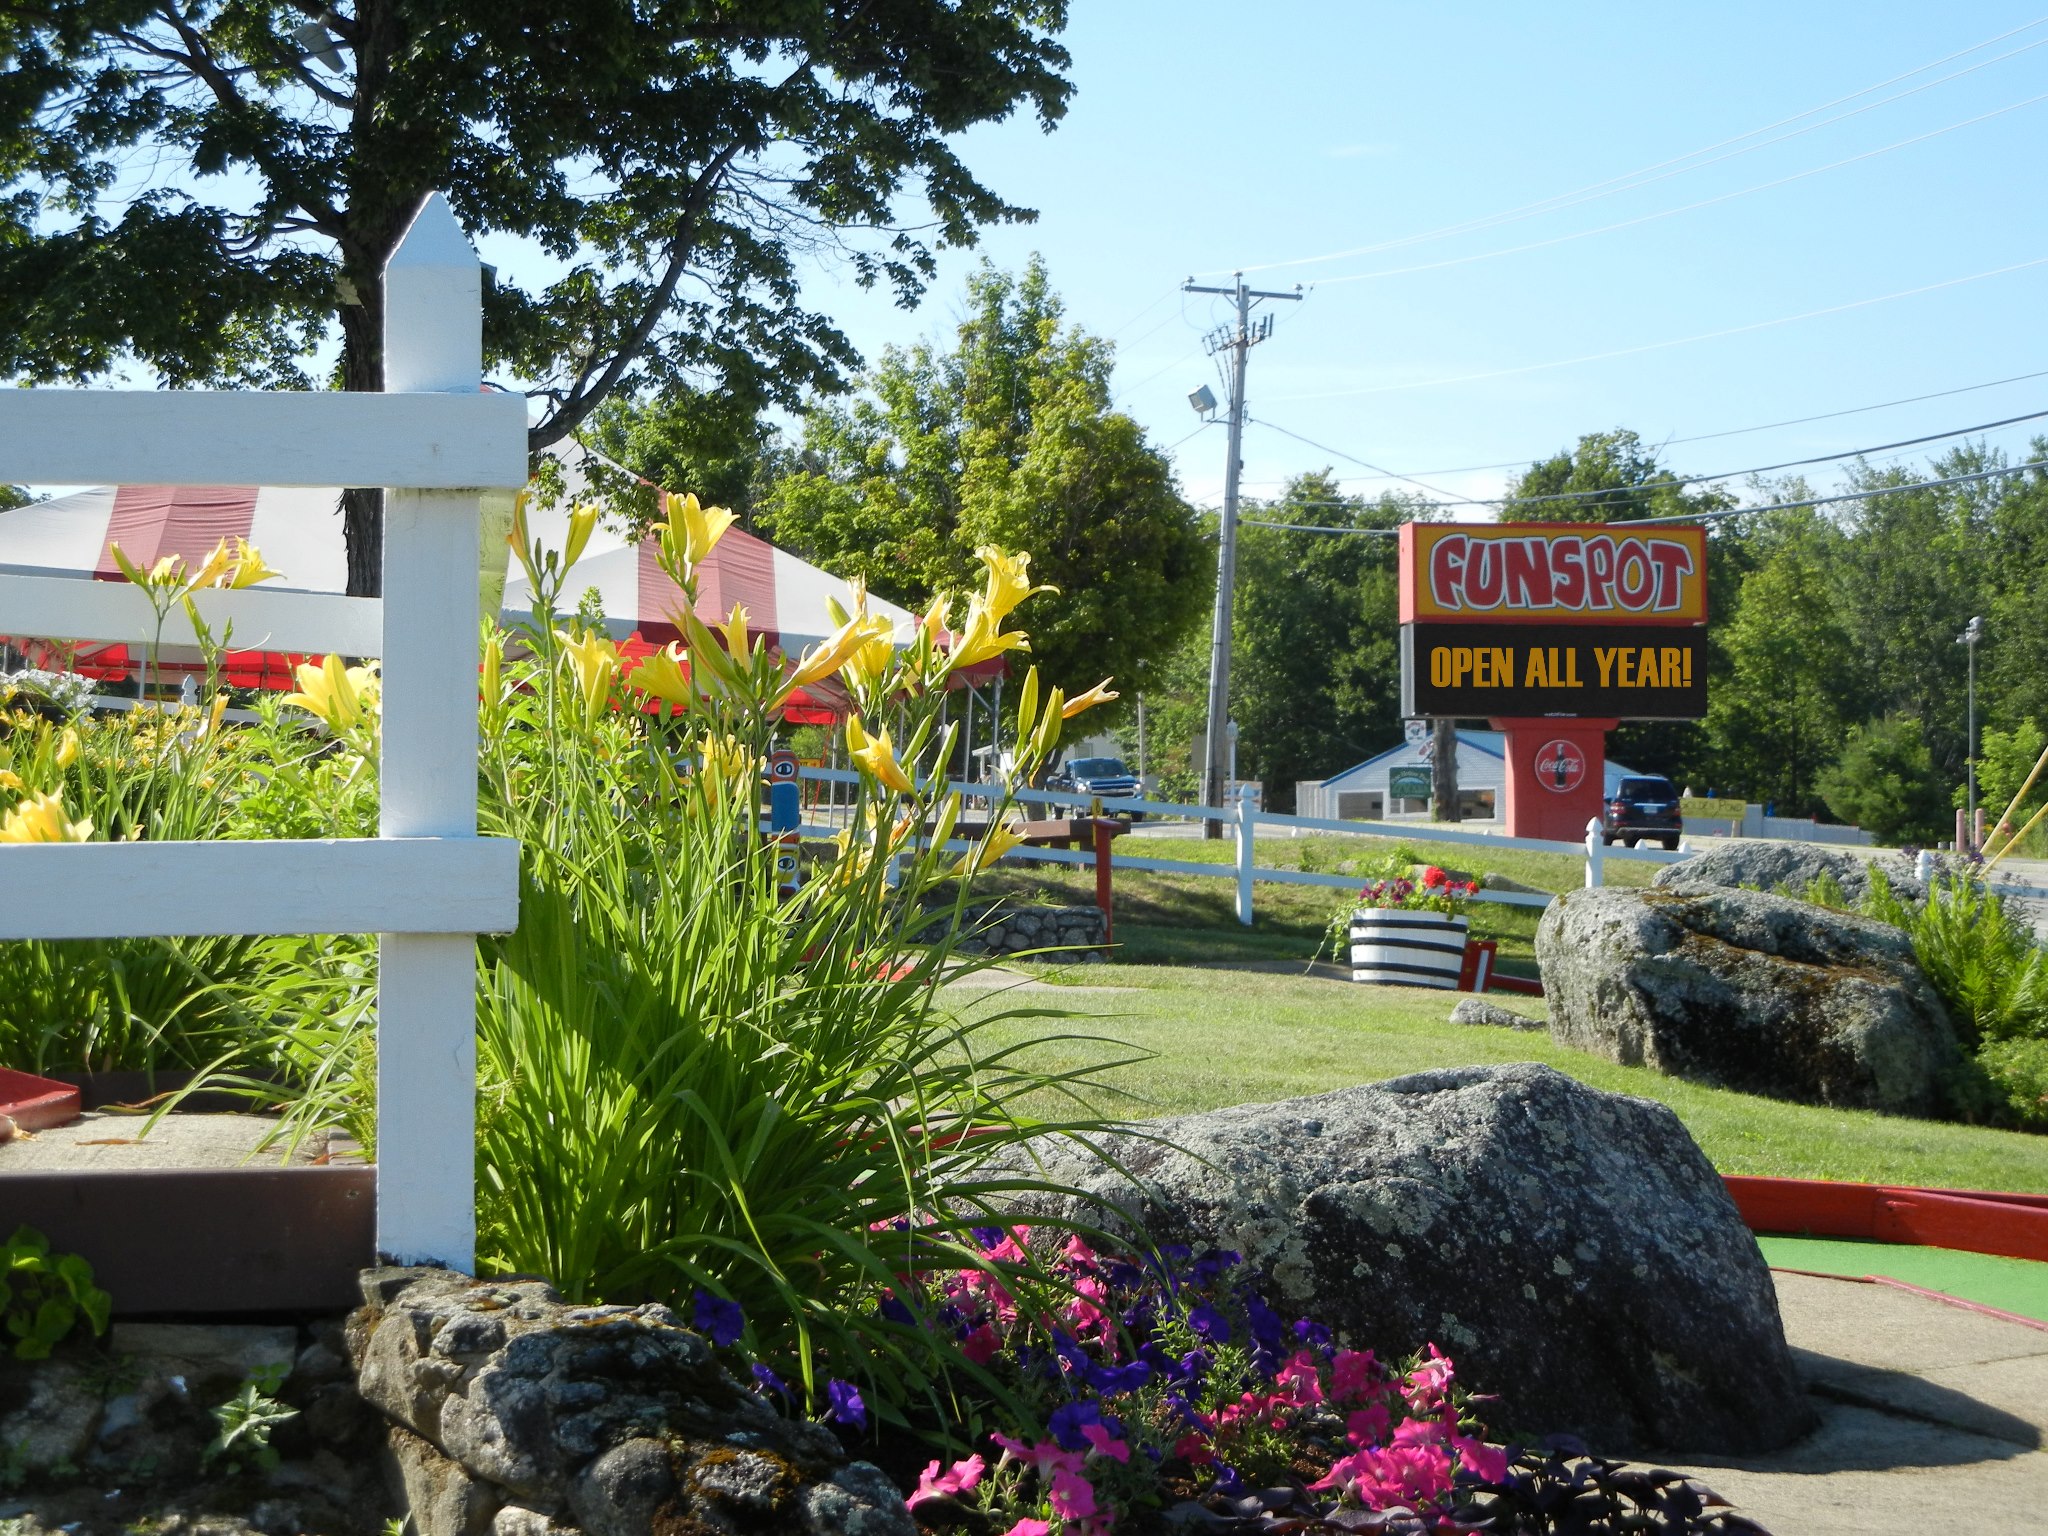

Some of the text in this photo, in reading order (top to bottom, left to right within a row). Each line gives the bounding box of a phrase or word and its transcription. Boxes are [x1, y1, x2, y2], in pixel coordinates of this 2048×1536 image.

[1430, 533, 1694, 612] FUNSPOT
[1430, 646, 1692, 688] OPEN ALL YEAR!
